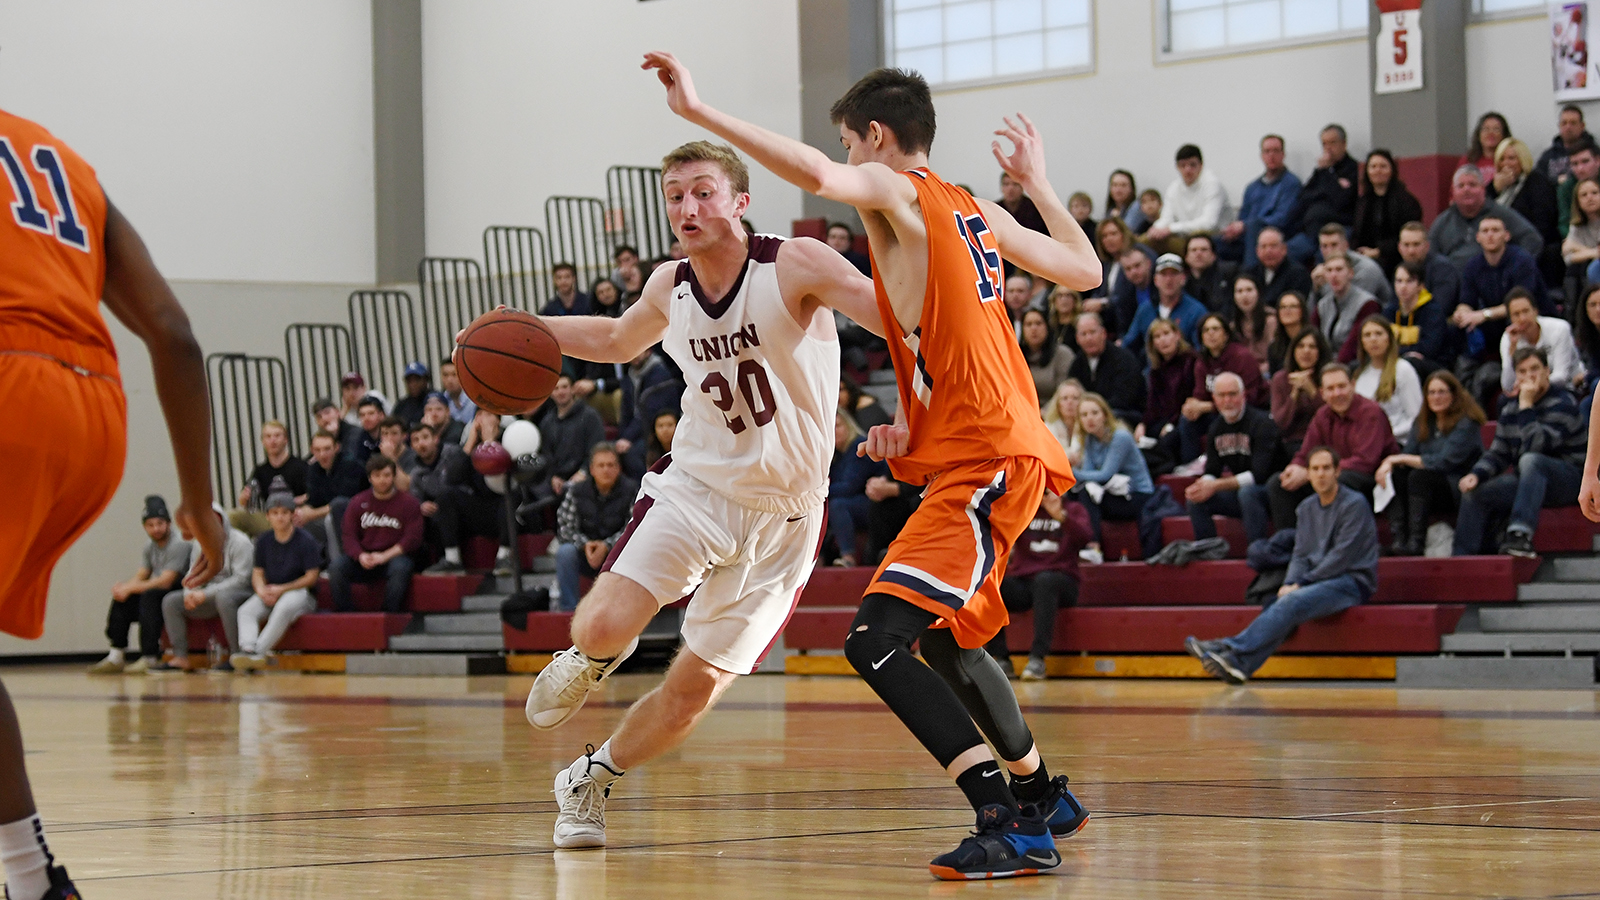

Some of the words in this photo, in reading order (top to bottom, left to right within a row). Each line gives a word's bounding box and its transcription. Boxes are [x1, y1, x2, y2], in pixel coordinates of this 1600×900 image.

[1394, 29, 1408, 66] 5
[0, 136, 91, 254] 11
[953, 211, 1003, 303] 15
[689, 323, 760, 361] UNION
[701, 359, 777, 434] 20
[361, 511, 401, 530] Union
